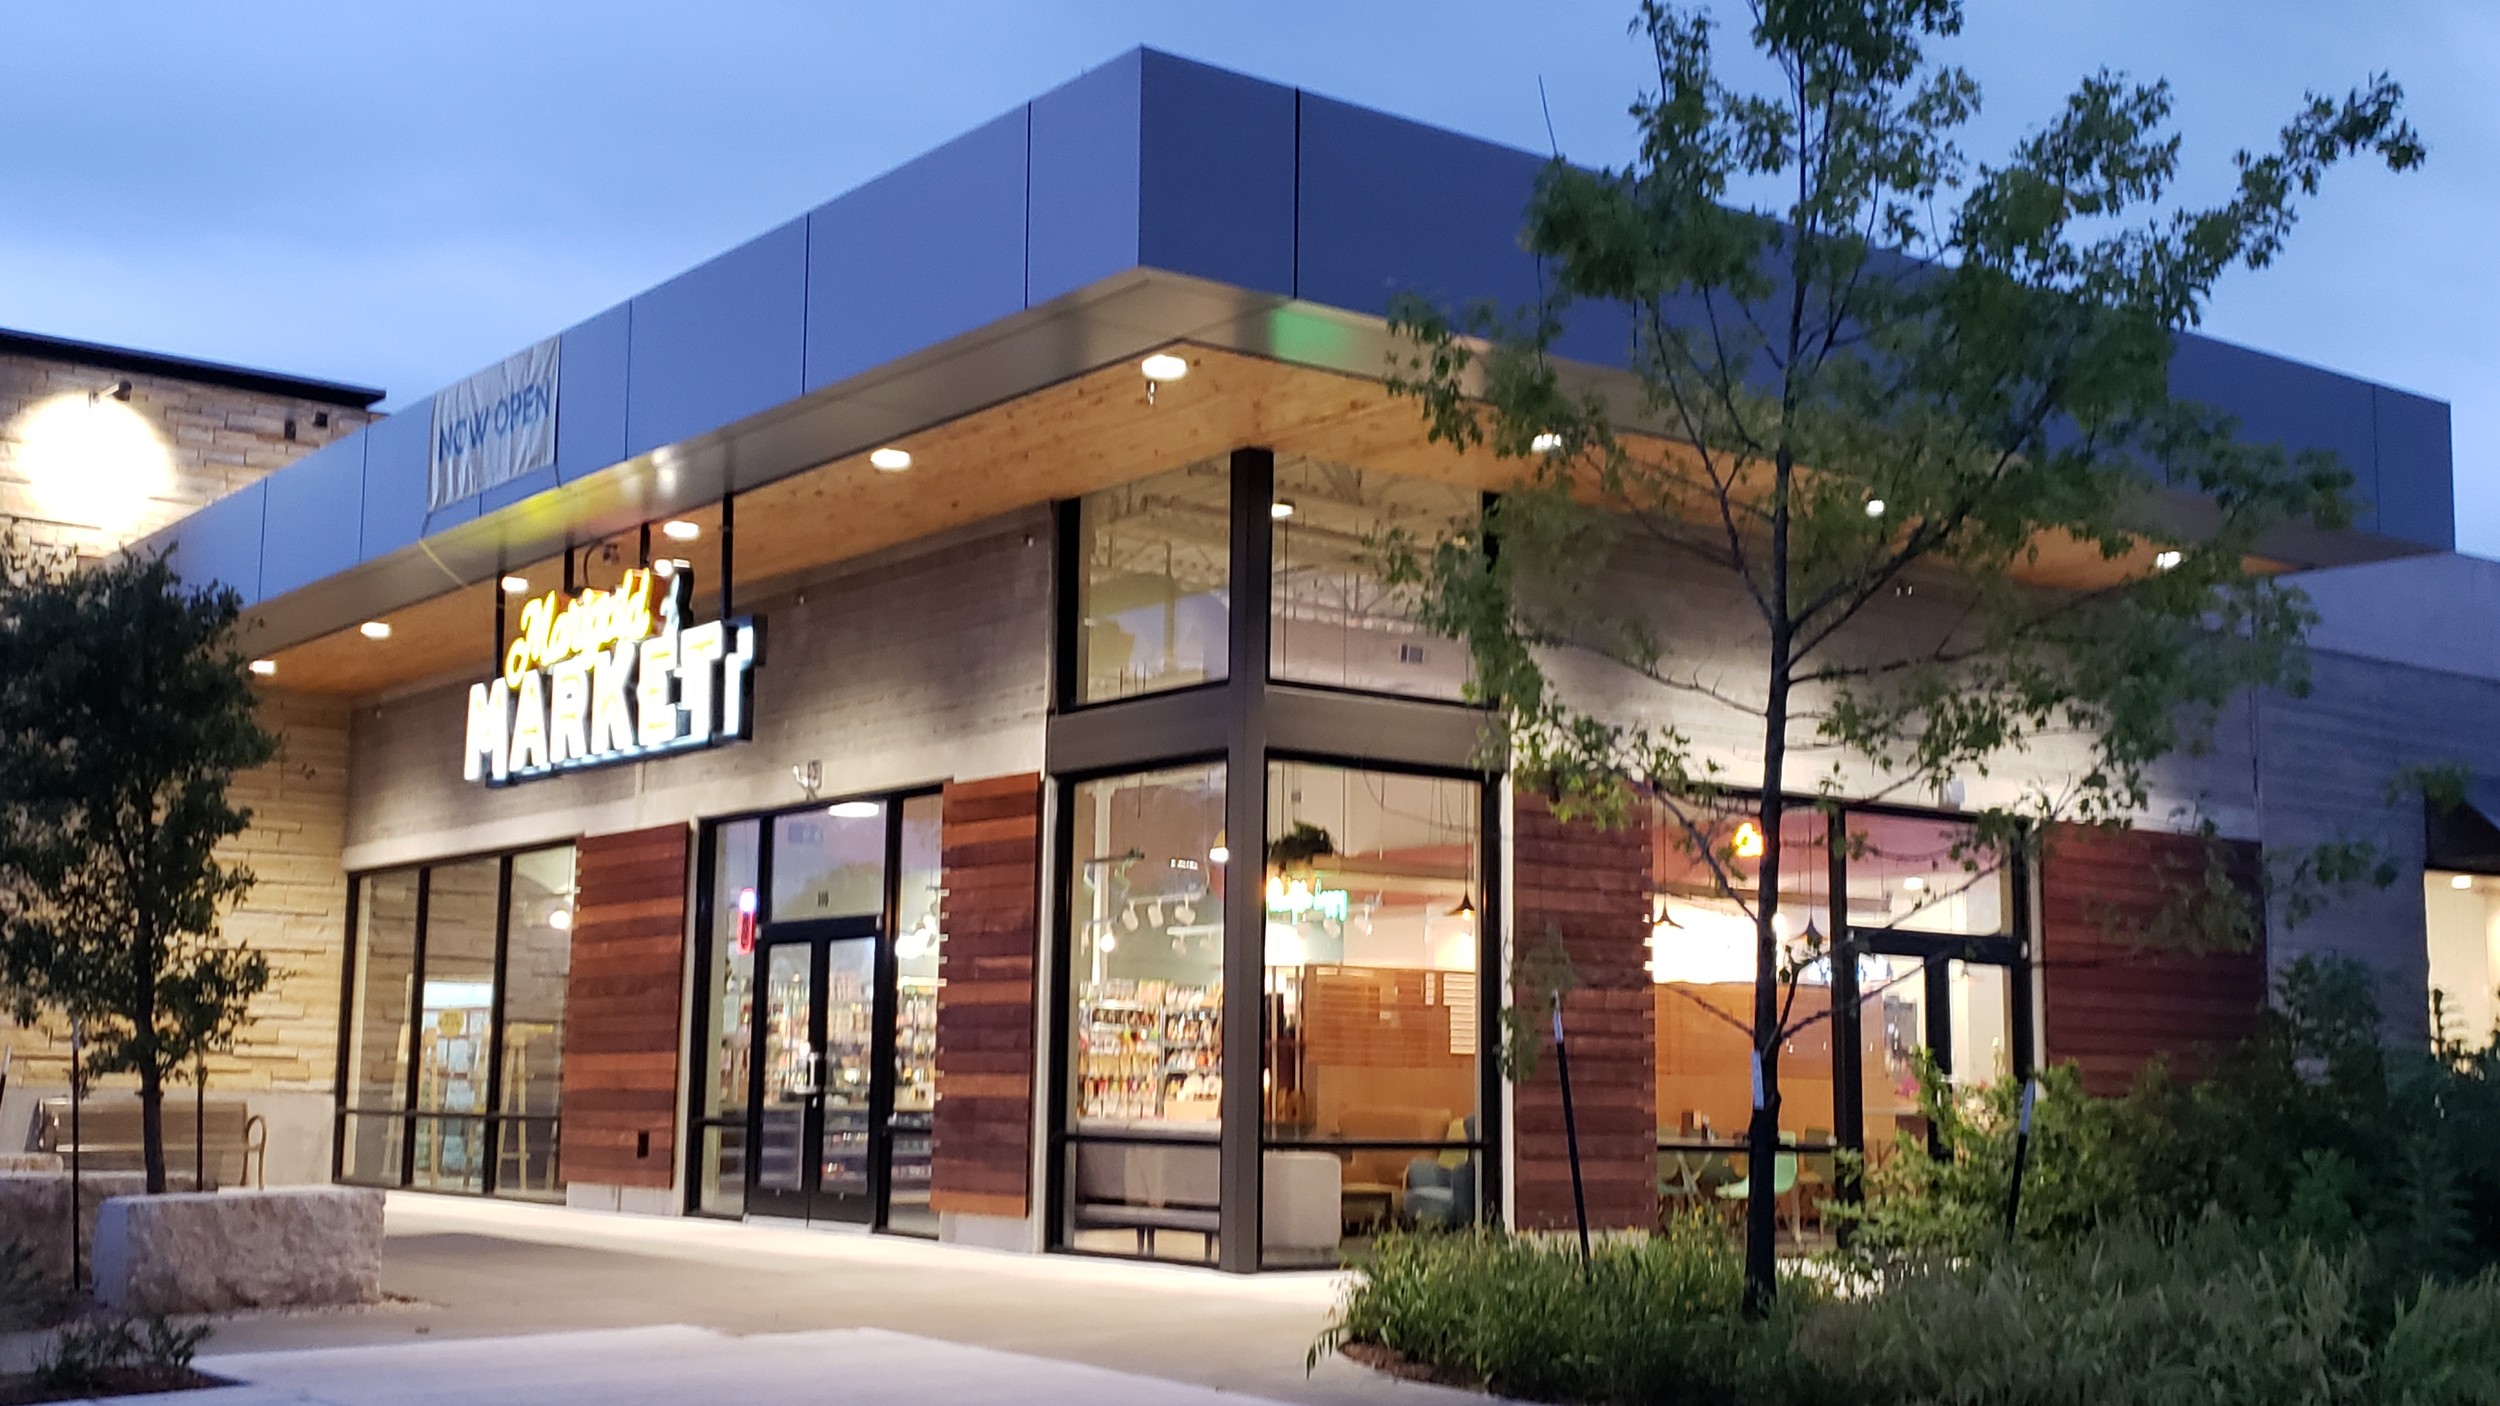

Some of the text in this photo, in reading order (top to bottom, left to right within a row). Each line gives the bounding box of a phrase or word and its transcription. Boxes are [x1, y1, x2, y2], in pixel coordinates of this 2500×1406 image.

[438, 378, 551, 462] NOW OPEN
[464, 619, 726, 782] MARKET
